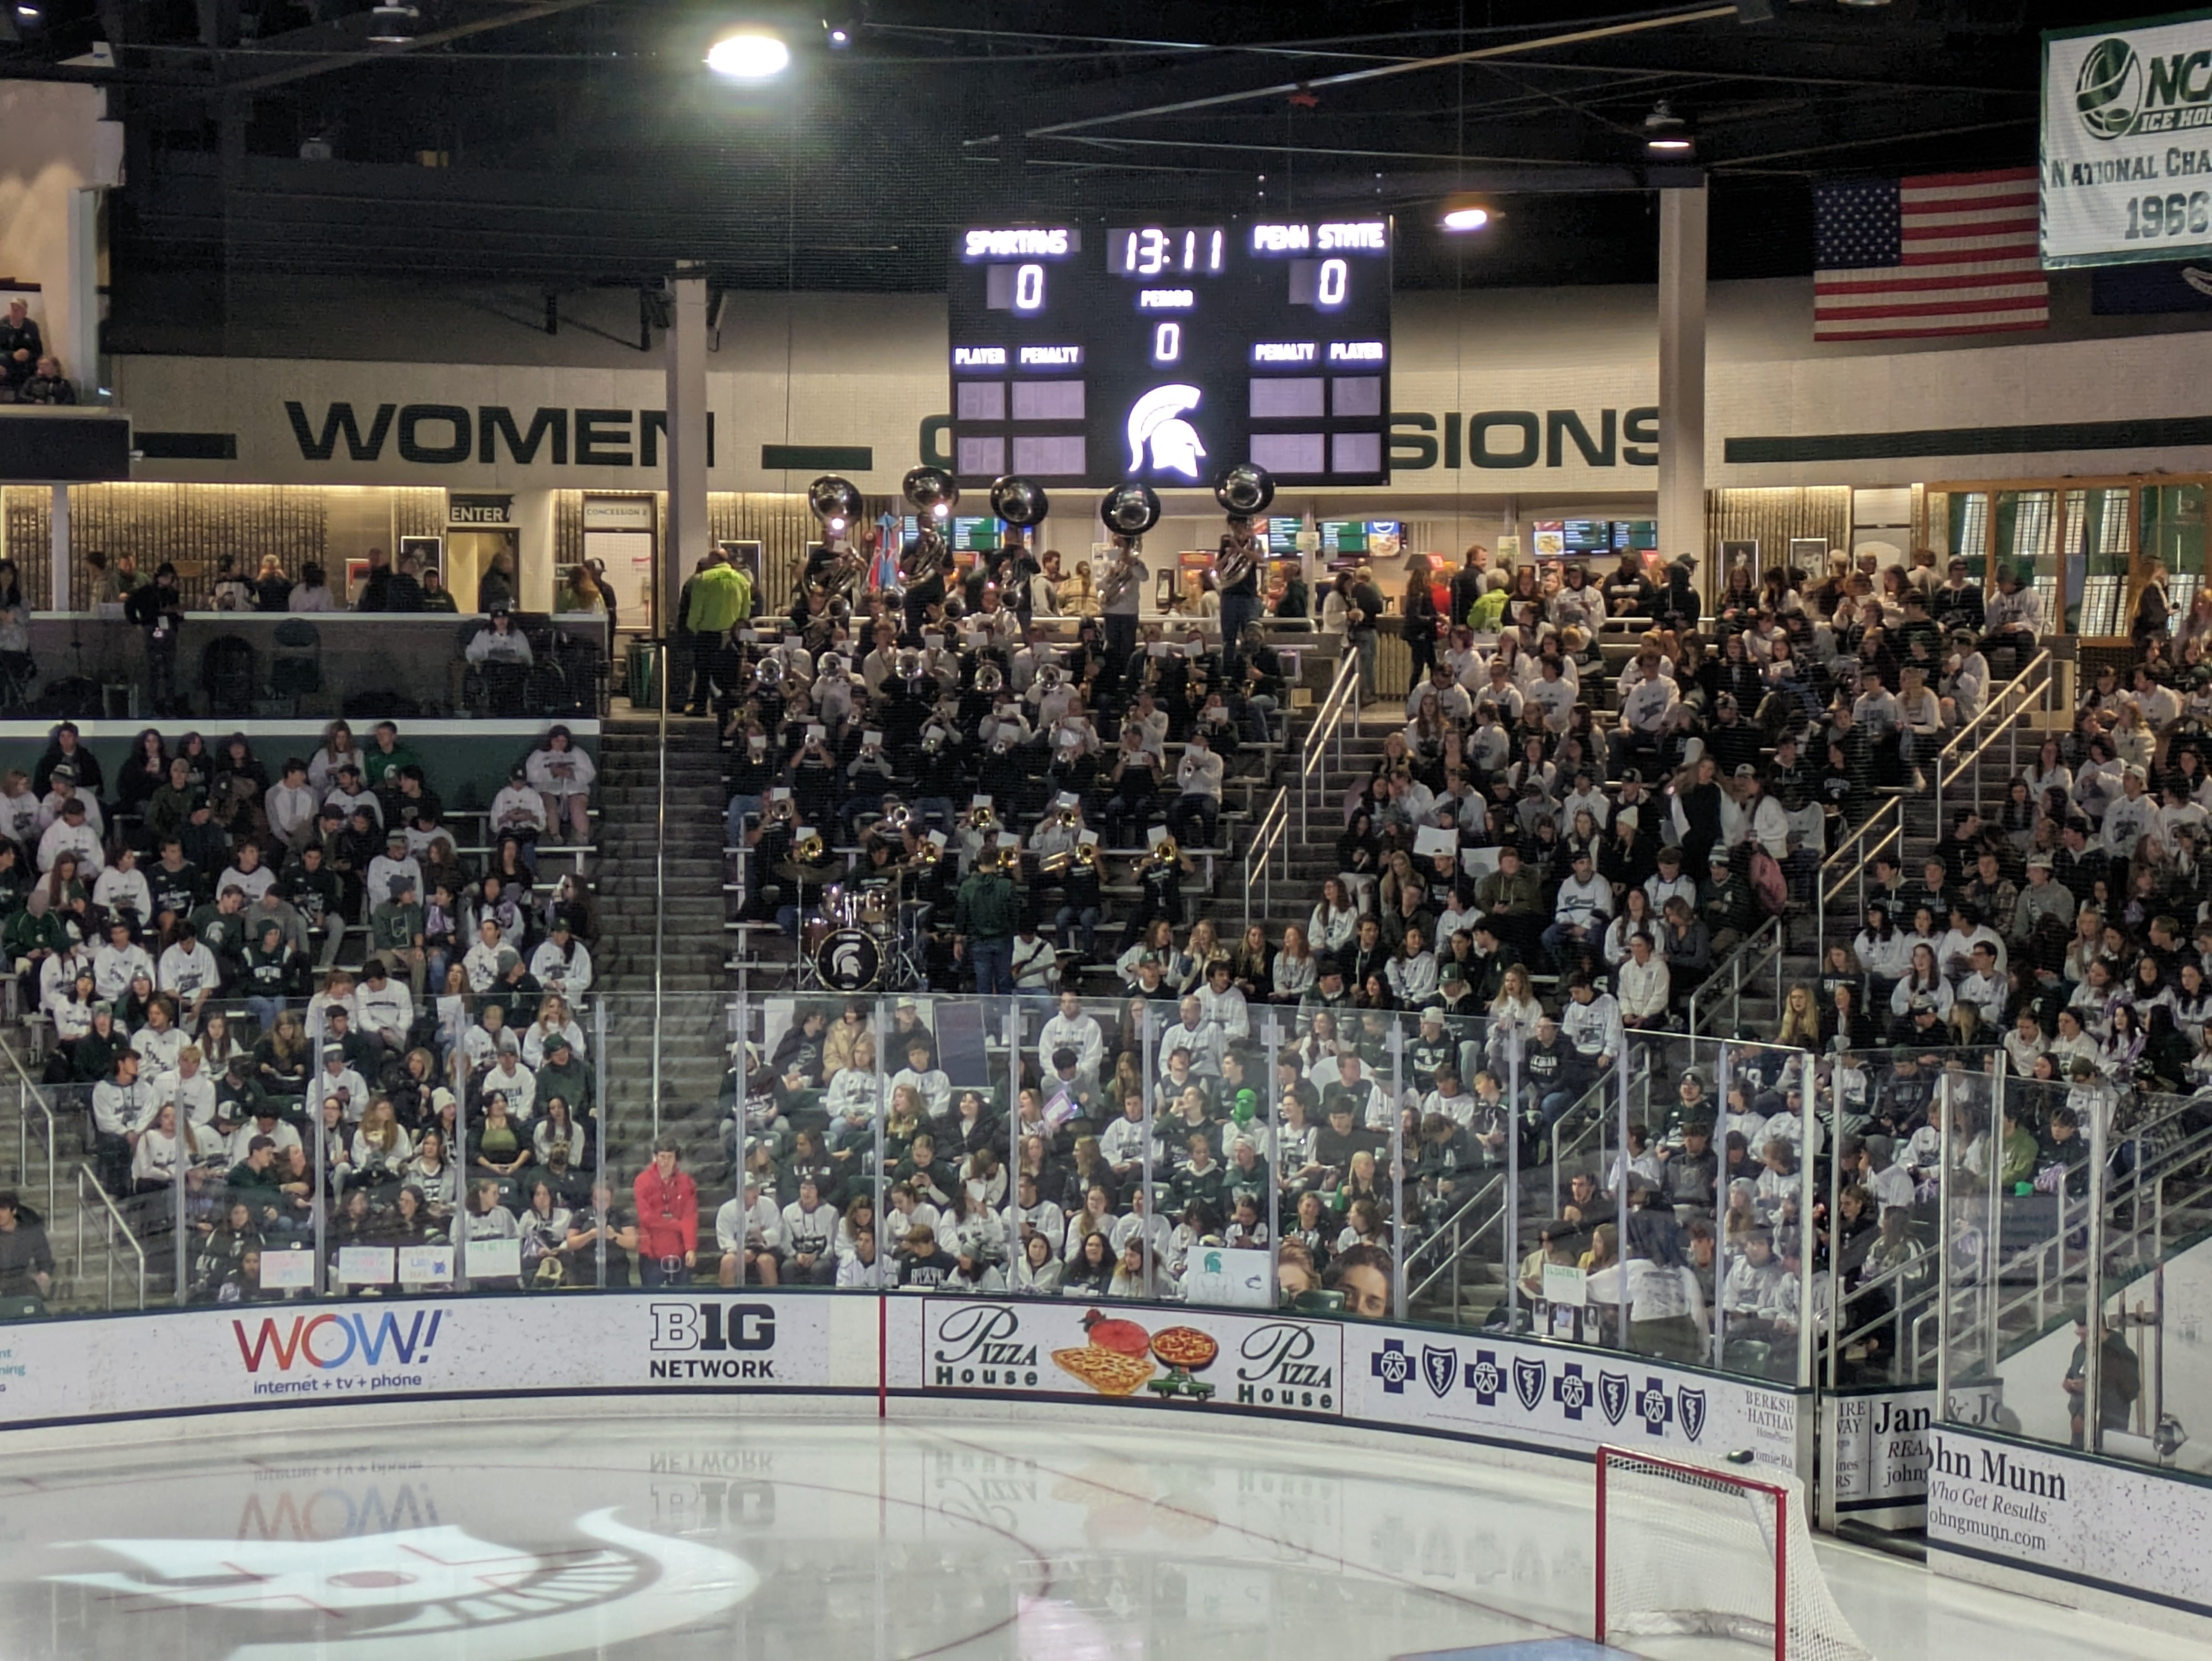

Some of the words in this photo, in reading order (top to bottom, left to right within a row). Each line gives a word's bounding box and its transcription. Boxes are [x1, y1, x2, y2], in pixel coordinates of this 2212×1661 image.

[2145, 49, 2212, 108] NC
[2140, 111, 2175, 132] ICE
[2051, 155, 2158, 188] NATIONAL
[2124, 191, 2209, 239] 1966
[966, 229, 1067, 255] SPARTANS
[1254, 225, 1309, 250] PENN
[1318, 223, 1385, 249] STATE
[1125, 228, 1222, 273] 13:11
[1016, 264, 1043, 309] 0
[1319, 259, 1347, 304] 0
[1140, 290, 1193, 307] PERIOD
[1020, 346, 1079, 364] PENALTY
[1155, 323, 1180, 361] 0
[1255, 343, 1315, 360] PENALTY
[1330, 343, 1383, 360] PLAYER
[955, 347, 1006, 365] PLAYER
[451, 507, 503, 521] ENTER
[232, 1309, 443, 1372] WOW!
[650, 1360, 774, 1378] NETWORK
[936, 1366, 1038, 1386] House
[254, 1378, 318, 1394] internet
[336, 1377, 353, 1389] tv
[371, 1374, 422, 1390] phone
[1238, 1384, 1332, 1408] House
[1875, 1402, 1930, 1434] Jan
[1888, 1440, 1930, 1459] REA
[1980, 1449, 2067, 1501] Munn
[1963, 1488, 1987, 1510] Get
[1992, 1495, 2047, 1524] Results
